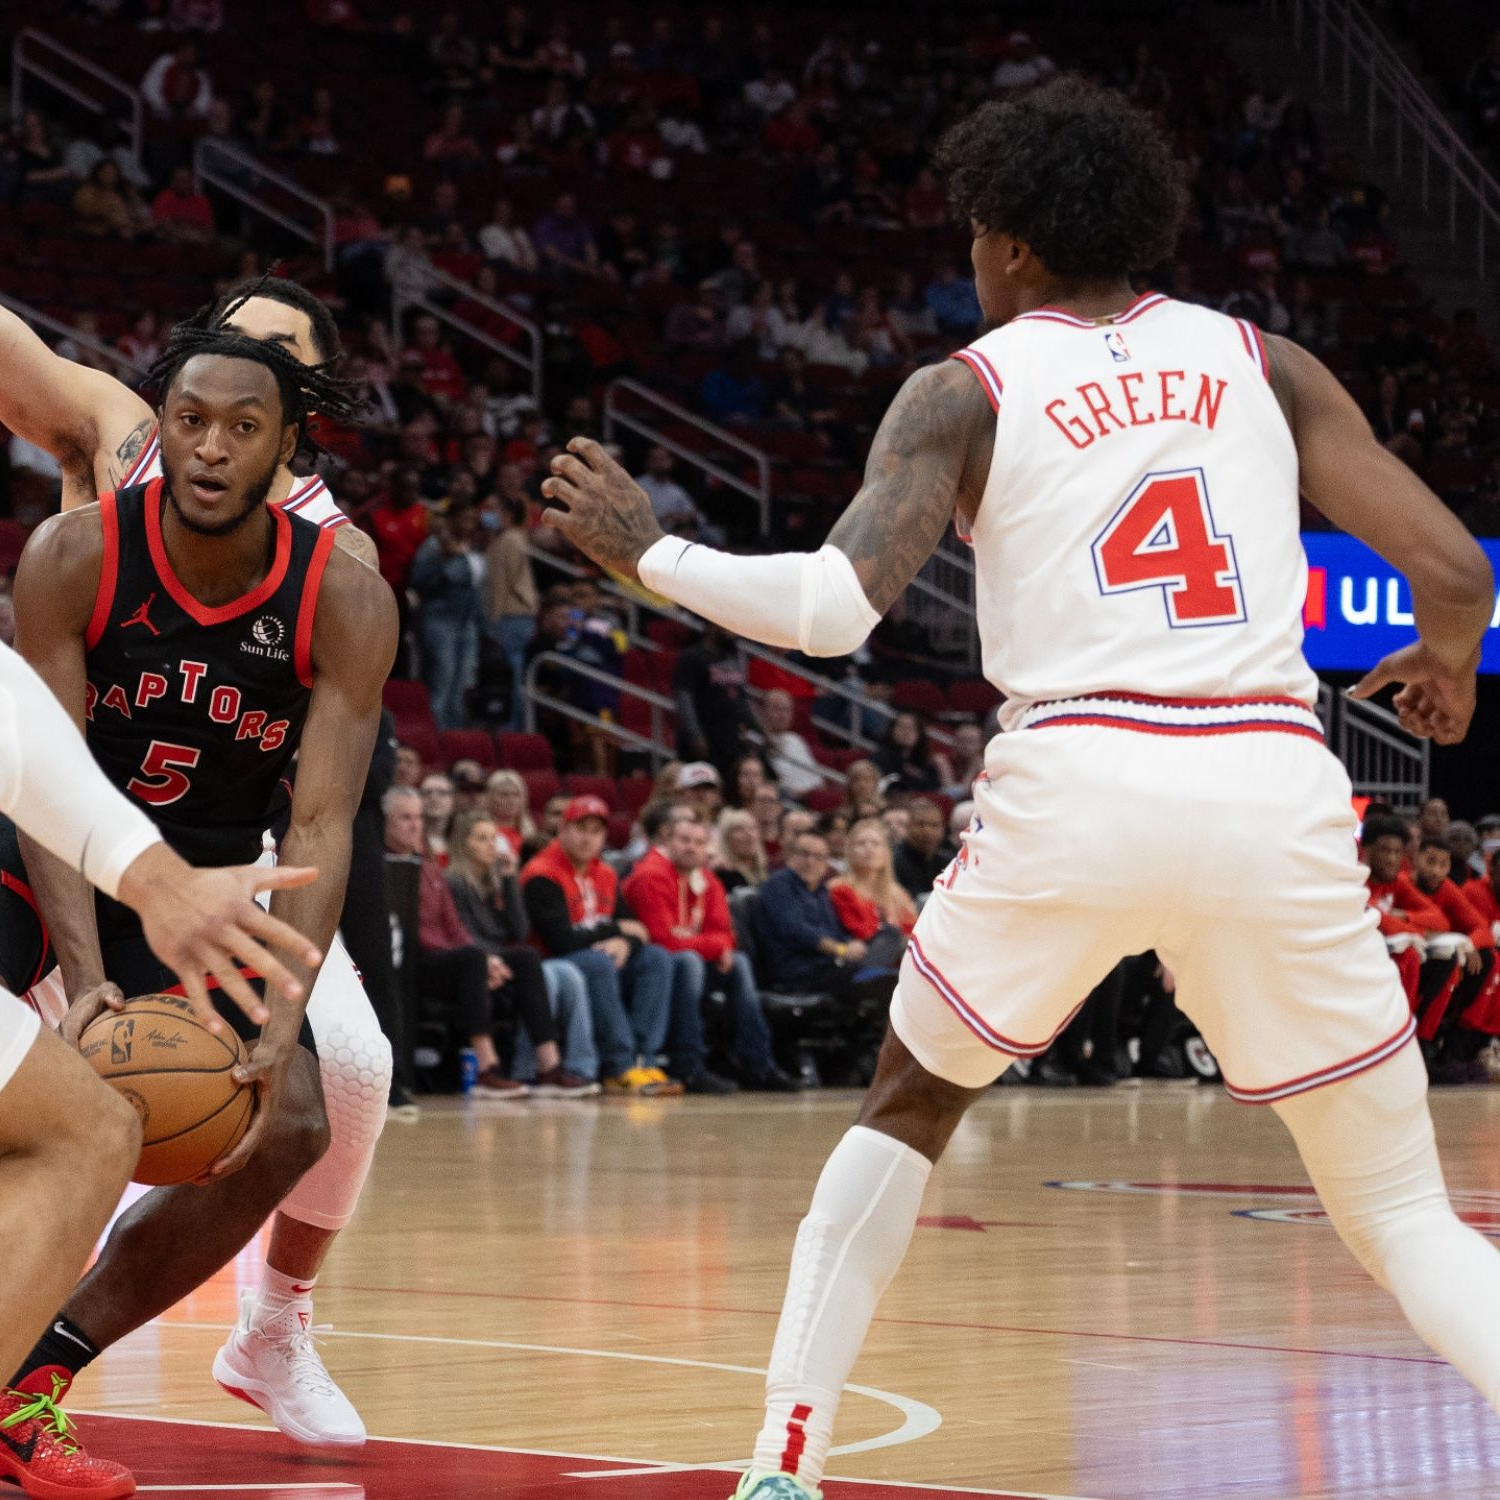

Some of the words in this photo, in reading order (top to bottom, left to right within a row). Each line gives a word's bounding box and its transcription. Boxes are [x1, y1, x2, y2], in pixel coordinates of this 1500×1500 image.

[1043, 369, 1229, 450] GREEN
[1091, 466, 1248, 630] 4
[239, 640, 264, 656] Sun
[266, 646, 290, 662] Life
[126, 739, 202, 806] 5
